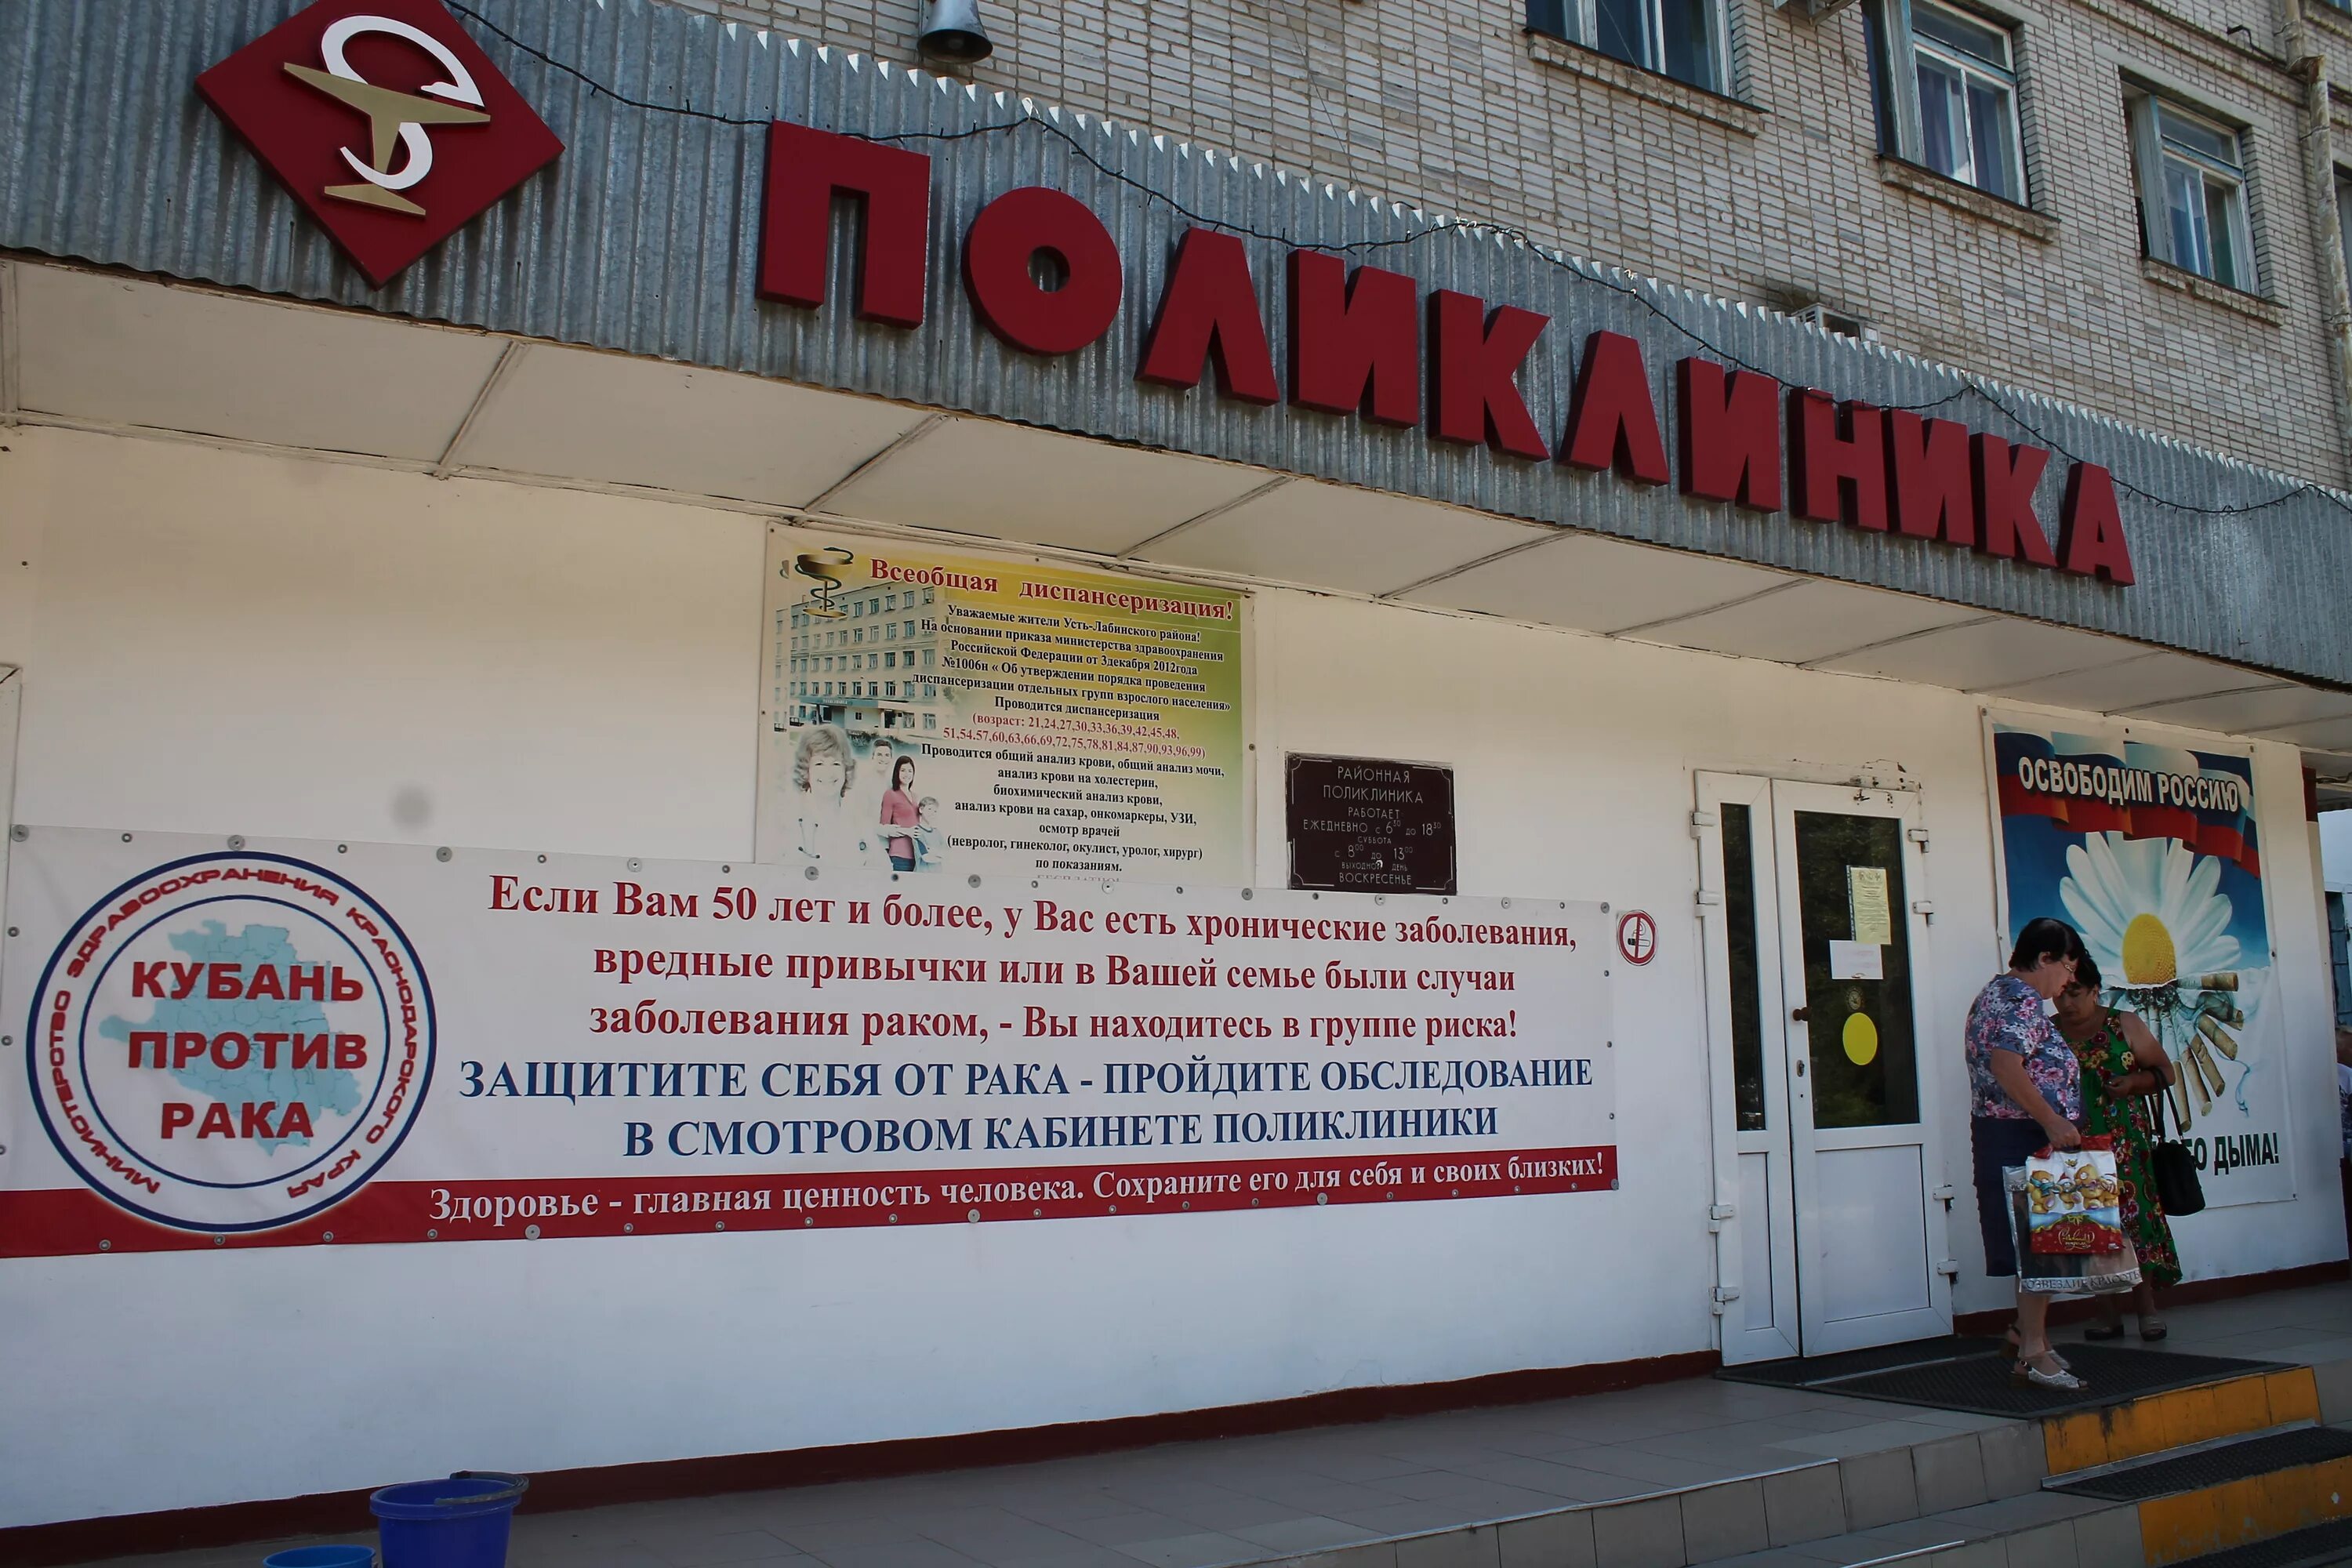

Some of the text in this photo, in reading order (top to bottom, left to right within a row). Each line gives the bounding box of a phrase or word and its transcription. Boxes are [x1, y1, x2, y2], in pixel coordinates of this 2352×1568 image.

[755, 119, 2136, 586] ПОЛИКЛИНИКА
[869, 558, 1232, 619] Всеобщая диспансеризация!
[920, 619, 1223, 662] На основании приказа министерства здравоохранения
[947, 604, 1200, 643] Уважаемые жители Усть-Лабинского района!
[950, 639, 1018, 658] Российской
[1020, 646, 1083, 666] Федерации
[1086, 655, 1099, 665] от
[912, 673, 1230, 710] диспансеризации отдельных групп взрослого населения»
[941, 655, 989, 672] №1006н
[1000, 662, 1018, 674] Об
[1020, 666, 1094, 682] утверждении
[1096, 671, 1142, 687] порядка
[1145, 677, 1206, 693] проведения
[994, 695, 1160, 721] Проводится диспансеризация
[972, 714, 1181, 741] (возраст: 21,24,27,30,33,36,39,42,45,48,
[921, 742, 1225, 777] Проводится общий анализ крови, общий анализ мочи,
[1338, 765, 1410, 783] РАЙОННАЯ
[993, 783, 1163, 808] биохимический анализ крови,
[997, 769, 1159, 790] анализ крови на холестерин,
[1323, 785, 1424, 804] ПОЛИКЛИНИКА
[2018, 757, 2239, 812] ОСВОБОДИМ РОССИЮ
[955, 801, 1197, 826] анализ крови на сахар, онкомаркеры, УЗИ,
[1039, 824, 1120, 839] осмотр врачей
[1303, 819, 1368, 833] ЕЖЕДНЕВНО
[1348, 807, 1399, 819] РАБОТАЕТ
[947, 834, 1203, 861] (невролог, гинеколог, окулист, уролог, хирург)
[1357, 836, 1392, 844] СУББОТА
[1035, 859, 1123, 872] по показаниям.
[1339, 873, 1411, 885] ВОСКРЕСЕНЬЕ
[488, 874, 1577, 951] Если Вам 50 лет и более, у Вас есть хронические заболевания,
[132, 961, 365, 1002] КУБАНЬ
[595, 948, 1515, 998] вредные привычки или в Вашей семье были случаи
[66, 868, 339, 978] ЗДРАВООХРАНЕНИЯ
[287, 1149, 361, 1198] КРАЯ
[590, 998, 850, 1036] заболевания
[862, 1011, 989, 1047] раком,
[1024, 1005, 1078, 1038] Вы
[1091, 1015, 1272, 1040] находитесь
[1282, 1015, 1301, 1039] в
[1310, 1016, 1417, 1047] группе
[1425, 1009, 1517, 1047] риска!
[128, 1031, 368, 1070] ПРОТИВ
[459, 1061, 747, 1106] ЗАЩИТИТЕ
[761, 1062, 883, 1098] СЕБЯ
[895, 1063, 953, 1097] ОТ
[964, 1063, 1070, 1095] РАКА
[1103, 1054, 1311, 1101] ПРОЙДИТЕ
[1320, 1058, 1593, 1096] ОБСЛЕДОВАНИЕ
[161, 1102, 314, 1139] РАКА
[622, 1107, 1499, 1156] В СМОТРОВОМ КАБИНЕТЕ ПОЛИКЛИНИКИ
[2214, 1132, 2279, 1176] ДЫМА!
[429, 1189, 599, 1226] Здоровье
[633, 1189, 772, 1214] главная
[782, 1185, 931, 1213] ценность
[940, 1180, 1085, 1203] человека.
[1093, 1171, 1242, 1198] Сохраните
[1249, 1171, 1288, 1192] его
[1294, 1170, 1341, 1191] для
[1349, 1160, 1403, 1187] себя
[1410, 1167, 1426, 1184] и
[1433, 1163, 1502, 1183] своих
[1508, 1152, 1602, 1180] близких!
